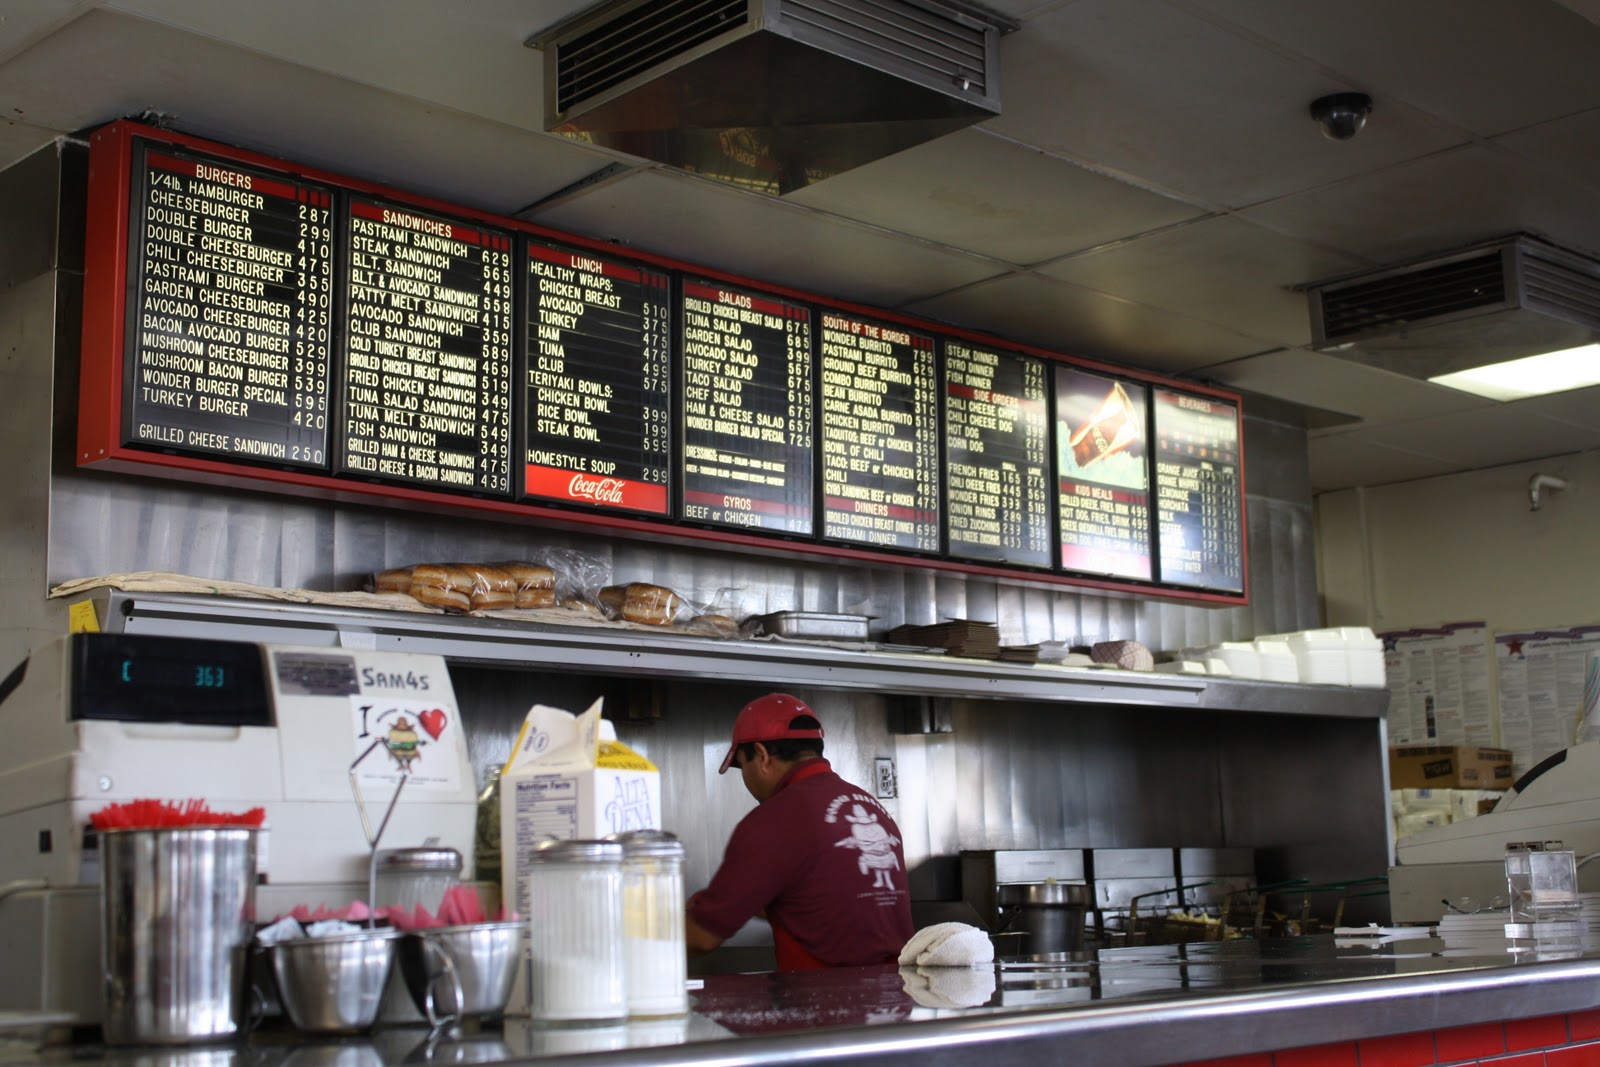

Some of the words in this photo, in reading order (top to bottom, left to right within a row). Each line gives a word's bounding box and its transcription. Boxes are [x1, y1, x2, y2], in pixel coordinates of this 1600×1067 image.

[196, 164, 251, 189] BURGERS
[150, 171, 182, 191] 1/4lb.
[189, 180, 263, 210] HAMBURGER
[151, 189, 249, 224] CHEESEBURGER
[148, 206, 197, 230] DOUBLE
[204, 219, 252, 241] BURGER
[383, 210, 451, 237] SANDWICHES
[148, 225, 195, 247] DOUBLE
[201, 236, 292, 267] CHEESEBURGER
[353, 219, 408, 244] PASTRAMI
[413, 233, 467, 258] SANDWICH
[146, 243, 180, 261] CHILI
[187, 250, 283, 283] CHEESEBURGER
[353, 236, 389, 256] STEAK
[395, 246, 450, 269] SANDWICH
[571, 255, 602, 274] LUNCH
[146, 260, 209, 285] PASTRAMI
[216, 275, 264, 296] BURGER
[531, 261, 575, 283] HEALTHY
[580, 273, 613, 292] WRAPS:
[145, 278, 193, 300] GARDEN
[200, 288, 291, 319] CHEESEBURGER
[351, 286, 386, 304] PATTY
[391, 294, 420, 311] MELT
[425, 302, 478, 323] SANDWICH
[539, 294, 584, 315] AVOCADO
[540, 279, 581, 300] CHICKEN
[585, 289, 621, 308] BREAST
[719, 291, 752, 309] SALADS
[145, 297, 198, 318] AVOCADO
[204, 307, 290, 336] CHEESEBURGER
[351, 303, 403, 324] AVOCADO
[408, 314, 463, 337] SANDWICH
[539, 309, 577, 329] TURKEY
[686, 313, 709, 328] TUNA
[713, 319, 741, 335] SALAD
[144, 314, 182, 334] BACON
[188, 323, 240, 344] AVOCADO
[246, 333, 289, 353] BURGER
[351, 319, 380, 336] CLUB
[385, 325, 441, 349] SANDWICH
[538, 326, 560, 341] HAM
[686, 327, 720, 344] GARDEN
[724, 335, 752, 351] SALAD
[823, 316, 849, 331] SOUTH
[852, 322, 862, 334] OF
[864, 325, 879, 338] THE
[882, 329, 910, 345] BORDER
[824, 330, 856, 347] WONDER
[859, 338, 891, 355] BURRITO
[143, 332, 204, 355] MUSHROOM
[208, 343, 288, 370] CHEESEBURGER
[539, 341, 564, 358] TUNA
[686, 343, 726, 360] AVOCADO
[730, 351, 758, 367] SALAD
[823, 343, 862, 361] PASTRAMI
[865, 352, 897, 369] BURRITO
[948, 345, 971, 356] STEAK
[973, 351, 999, 366] DINNER
[142, 350, 204, 373] MUSHROOM
[208, 362, 243, 380] BACON
[248, 369, 288, 388] BURGER
[538, 357, 564, 373] CLUB
[686, 357, 721, 374] TURKEY
[725, 364, 752, 380] SALAD
[143, 369, 190, 389] WONDER
[196, 378, 239, 397] BURGER
[244, 385, 288, 405] SPECIAL
[350, 369, 379, 387] FRIED
[383, 376, 424, 395] CHICKEN
[429, 384, 476, 404] SANDWICH
[529, 370, 574, 391] TERIYAKI
[579, 380, 613, 398] BOWLS:
[686, 386, 709, 401] CHEF
[713, 391, 741, 407] SALAD
[142, 387, 193, 408] TURKEY
[200, 397, 248, 417] BURGER
[349, 386, 378, 404] TUNA
[384, 392, 418, 411] SALAD
[423, 399, 476, 420] SANDWICH
[538, 388, 580, 407] CHICKEN
[584, 397, 610, 413] BOWL
[538, 404, 560, 419] RICE
[565, 408, 591, 425] BOWL
[139, 424, 184, 443] GRILLED
[189, 431, 229, 450] CHEESE
[234, 438, 285, 458] SANDWICH
[348, 420, 374, 437] FISH
[380, 425, 436, 446] SANDWICH
[538, 419, 569, 436] STEAK
[574, 426, 600, 442] BOWL
[948, 423, 962, 435] HOT
[965, 427, 979, 439] DOG
[528, 450, 587, 471] HOMESTYLE
[591, 460, 616, 475] SOUP
[825, 441, 847, 455] BOWL
[850, 445, 861, 456] OF
[864, 447, 884, 461] CHILI
[686, 505, 709, 519] BEEF
[713, 512, 720, 520] or
[724, 510, 761, 526] CHICKEN
[724, 496, 752, 510] GYROS
[855, 501, 888, 516] DINNERS
[517, 782, 548, 791] Nutrition
[550, 781, 570, 790] Facts
[614, 776, 648, 806] ALTA
